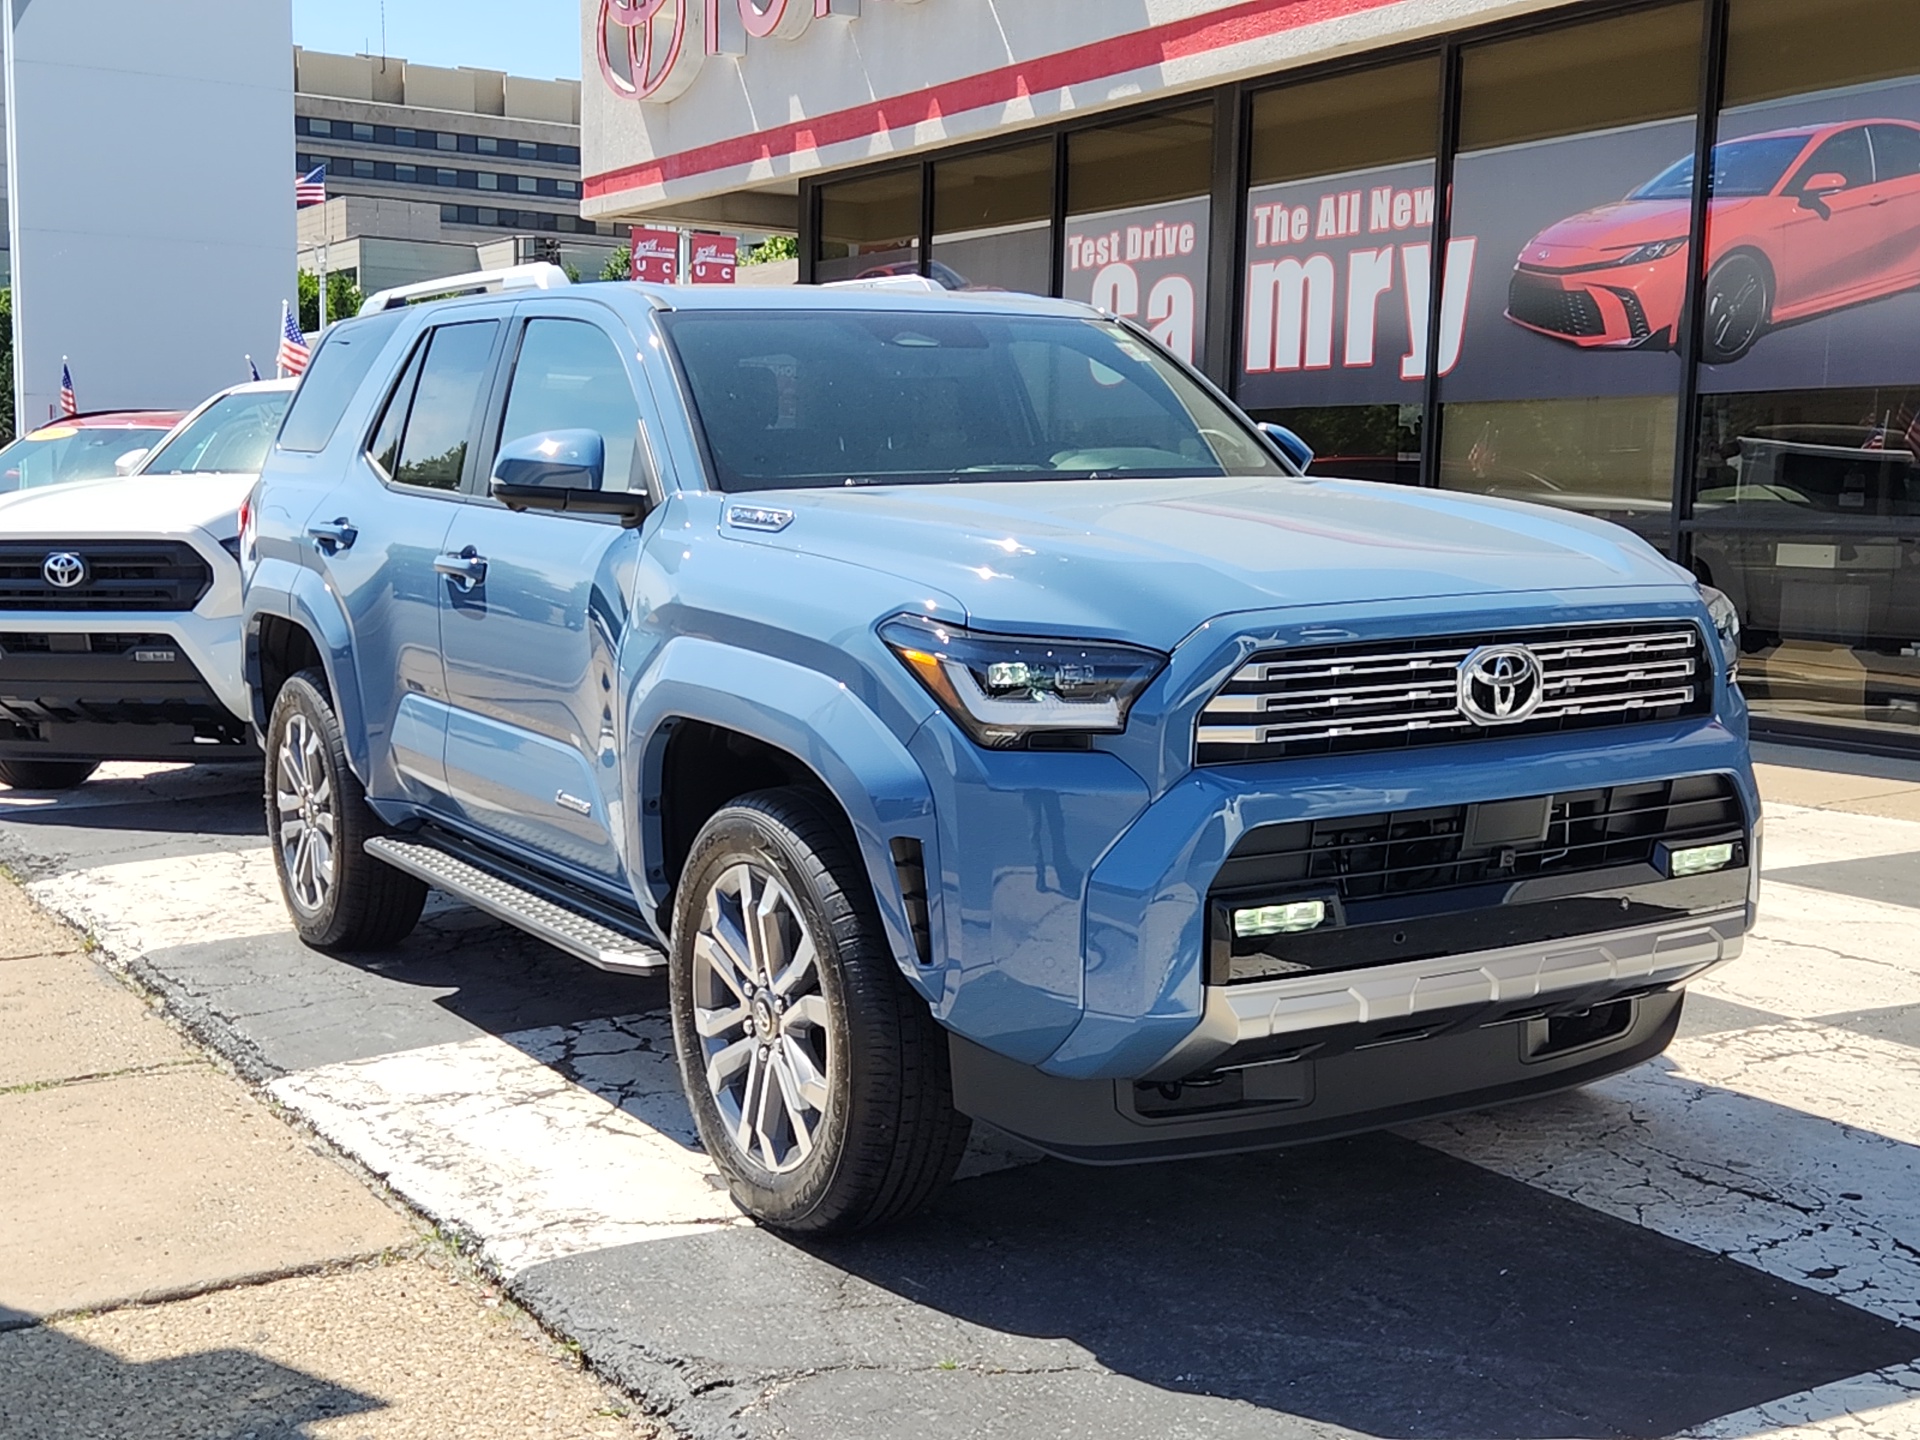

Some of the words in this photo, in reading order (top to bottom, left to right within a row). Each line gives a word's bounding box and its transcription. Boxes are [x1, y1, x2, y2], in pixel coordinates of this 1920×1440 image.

[1068, 231, 1120, 270] Test
[1126, 222, 1195, 261] Drive
[1254, 203, 1309, 246] The
[1315, 190, 1361, 238] All
[1369, 184, 1435, 232] New
